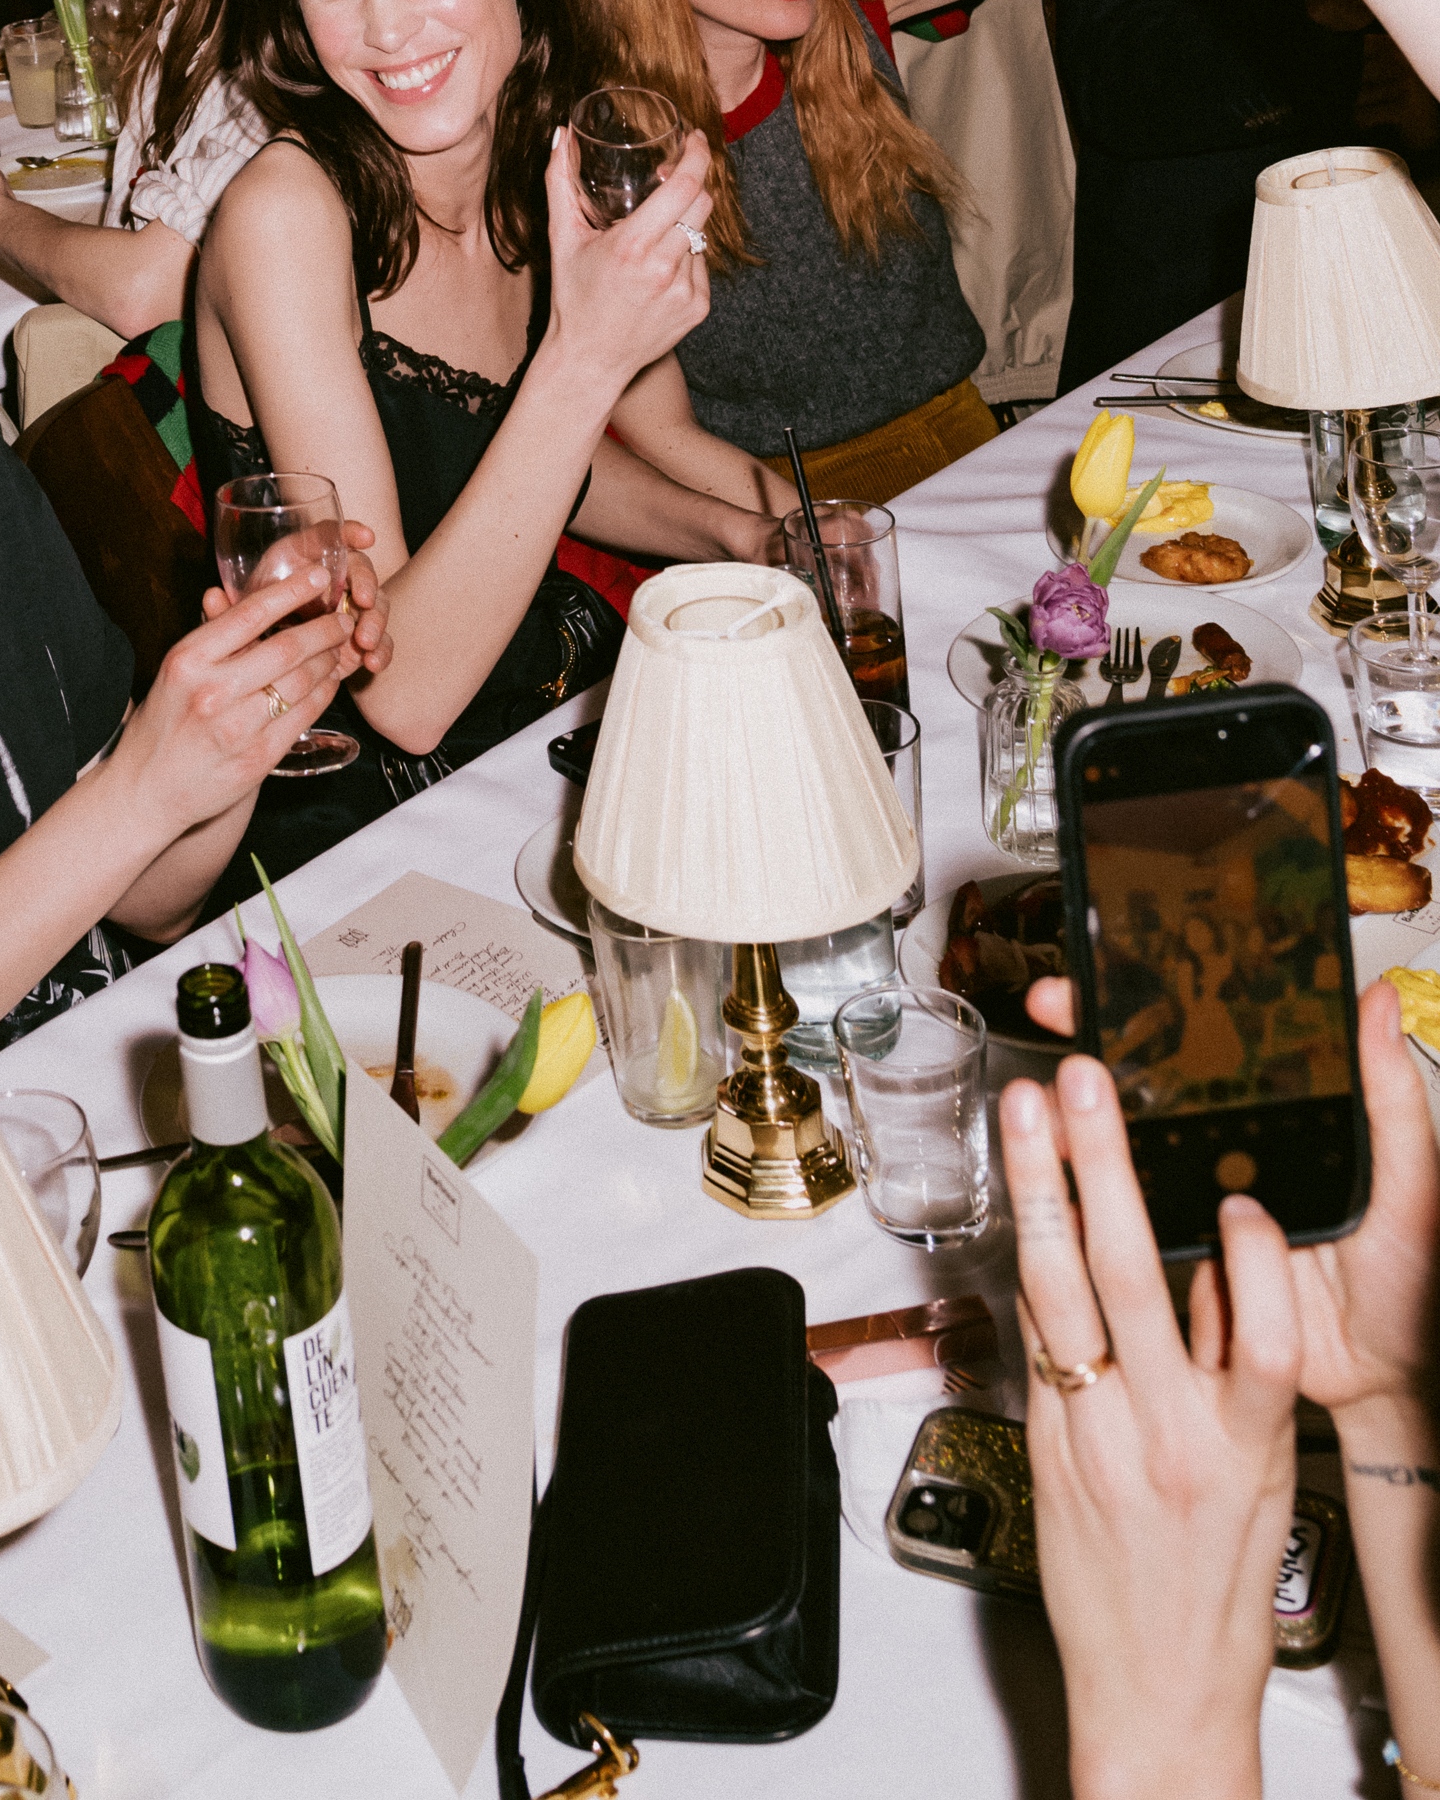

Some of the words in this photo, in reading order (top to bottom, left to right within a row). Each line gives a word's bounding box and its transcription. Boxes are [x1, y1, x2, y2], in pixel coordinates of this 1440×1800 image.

[303, 1329, 324, 1361] DE
[306, 1350, 332, 1386] LIN
[309, 1358, 348, 1410] CUEN
[312, 1407, 333, 1433] TE
